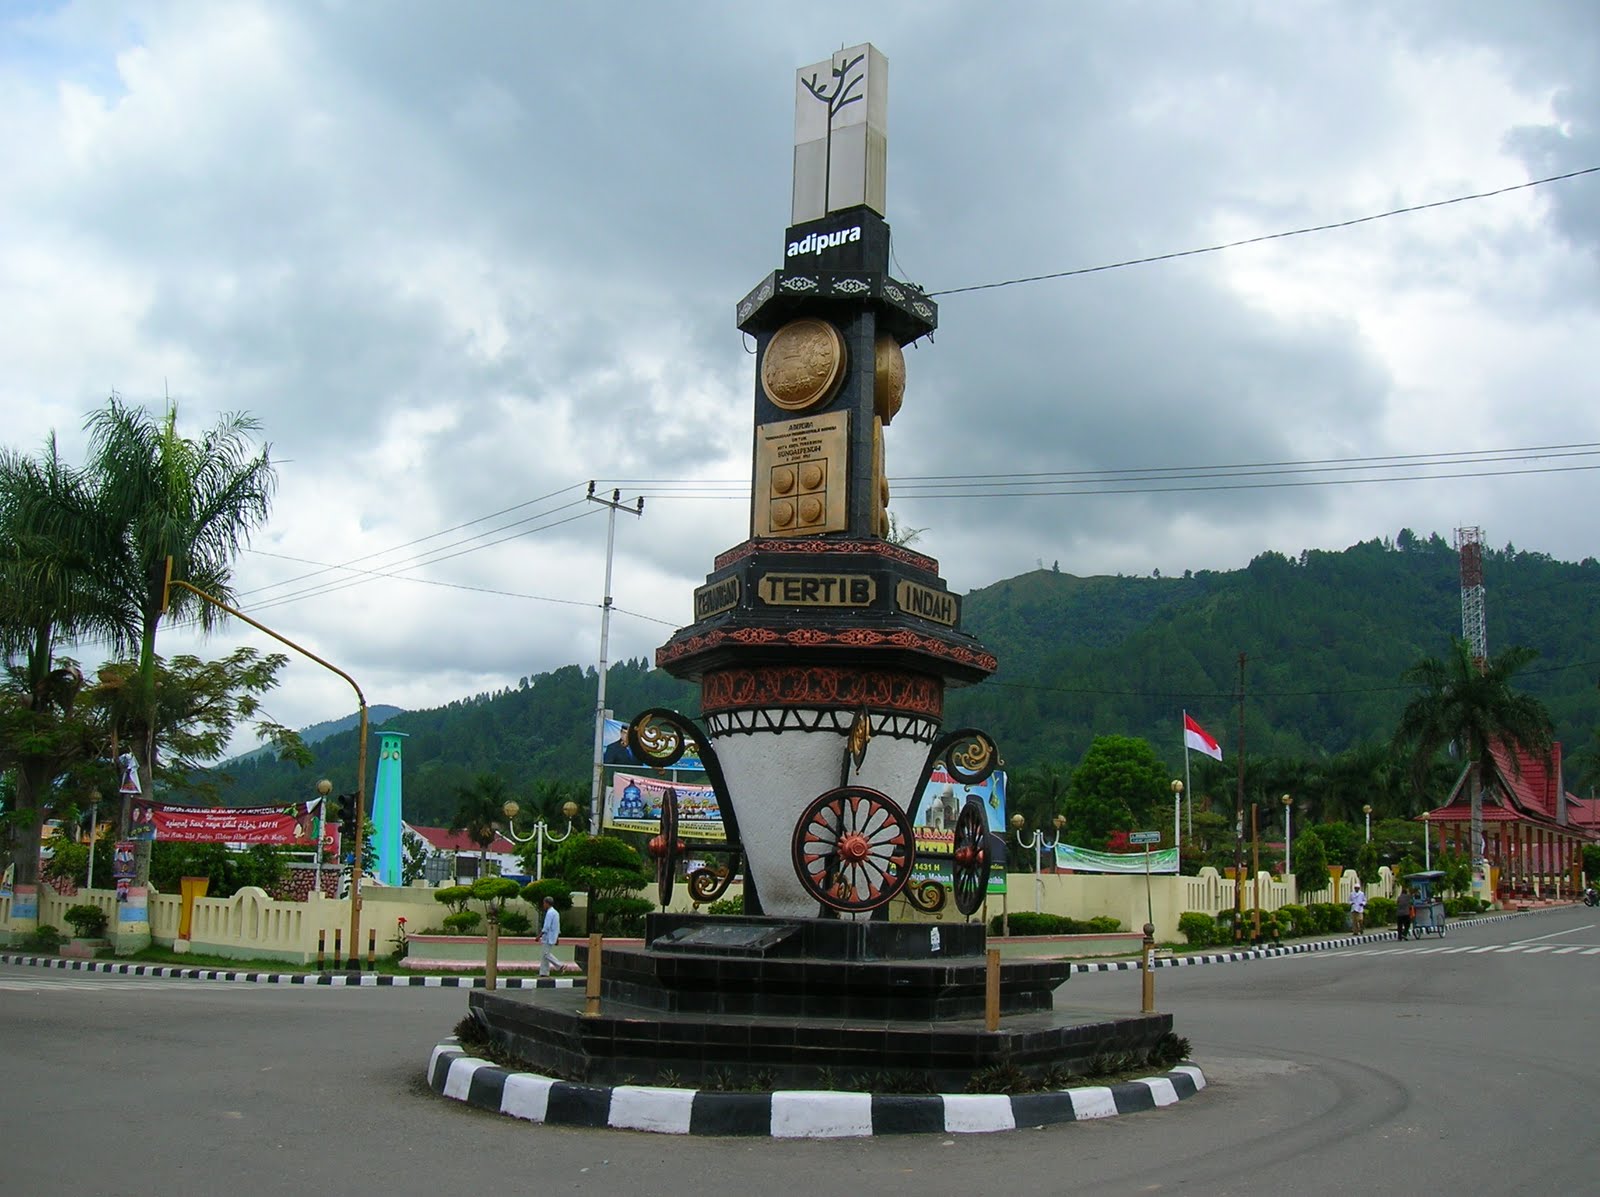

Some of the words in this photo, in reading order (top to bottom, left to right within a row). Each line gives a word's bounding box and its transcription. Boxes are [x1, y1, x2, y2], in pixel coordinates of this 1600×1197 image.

[787, 226, 861, 257] adipura
[766, 576, 870, 603] TERTIB
[906, 586, 951, 622] INDAH
[914, 863, 932, 871] 1431
[933, 863, 940, 871] H
